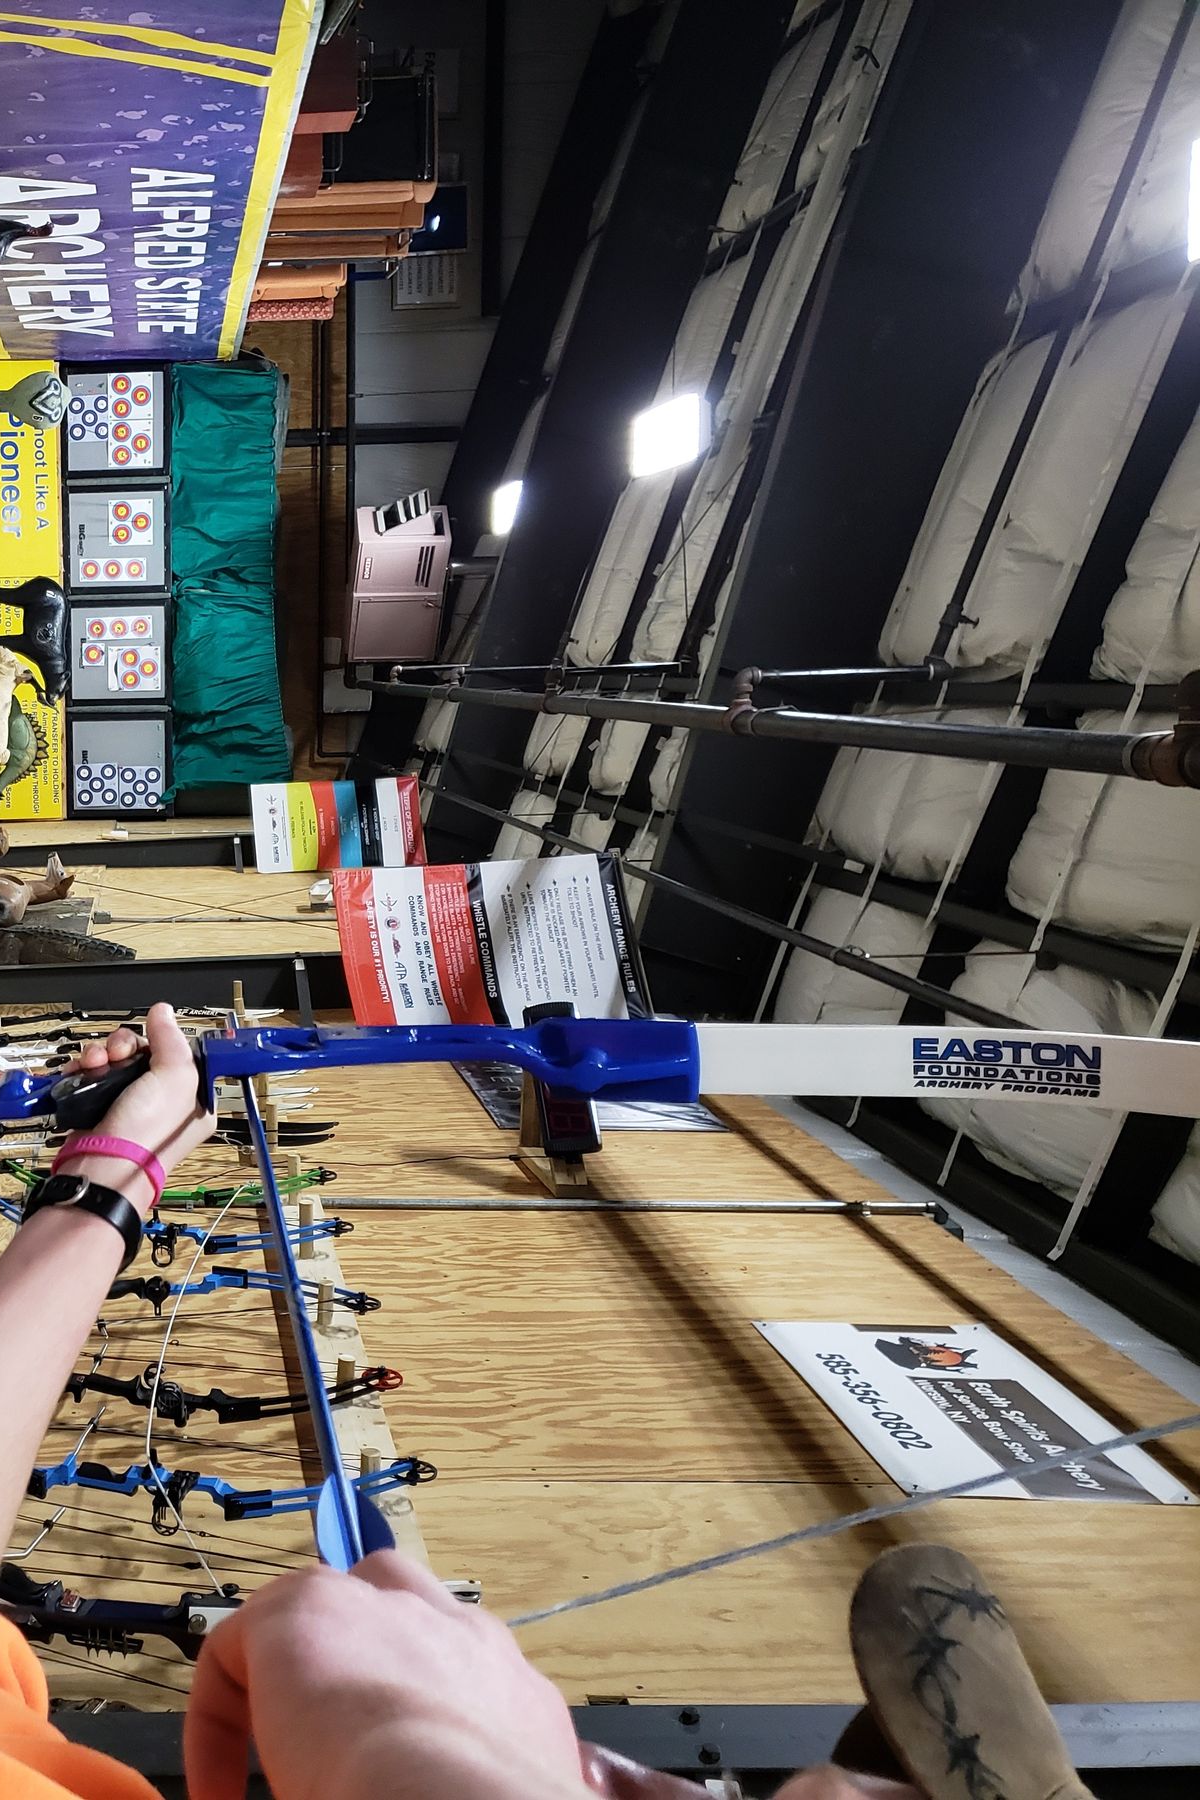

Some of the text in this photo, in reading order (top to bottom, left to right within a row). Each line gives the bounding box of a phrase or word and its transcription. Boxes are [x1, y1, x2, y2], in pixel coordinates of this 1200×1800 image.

[130, 168, 215, 334] ALFRED STATE
[0, 409, 25, 537] Pioneer
[34, 427, 50, 530] hoot Like A
[4, 617, 11, 627] TO
[51, 712, 59, 753] TRANSFER
[52, 756, 59, 766] TO
[404, 811, 412, 820] OF
[406, 821, 415, 853] SHOOTING
[364, 900, 390, 1003] SAFETY IS OUR #1 PRIORITY!
[408, 896, 434, 1006] COMMANDS AND RANGE RULES
[416, 895, 443, 1006] KNOW AND OBEY ALL WHISTLE
[472, 900, 498, 998] WHISTLE COMMANDS
[514, 929, 524, 962] EMERGENCY
[606, 883, 636, 993] ARCHERY RANGE RULES
[394, 961, 407, 981] ATA
[568, 971, 576, 987] WHEN
[401, 983, 414, 1008] EASTON
[542, 977, 552, 1000] GROUND
[570, 988, 578, 997] AN
[913, 1038, 1101, 1069] EASTON
[913, 1064, 1101, 1085] FOUNDATIONS
[914, 1079, 1100, 1098] ARCHERY PROGRAMS
[816, 1353, 933, 1449] 585-356-0802
[946, 1411, 972, 1423] NY
[968, 1381, 1012, 1407] Earth
[999, 1410, 1050, 1440] Spirits
[938, 1381, 1036, 1463] Full Service Bow Shop
